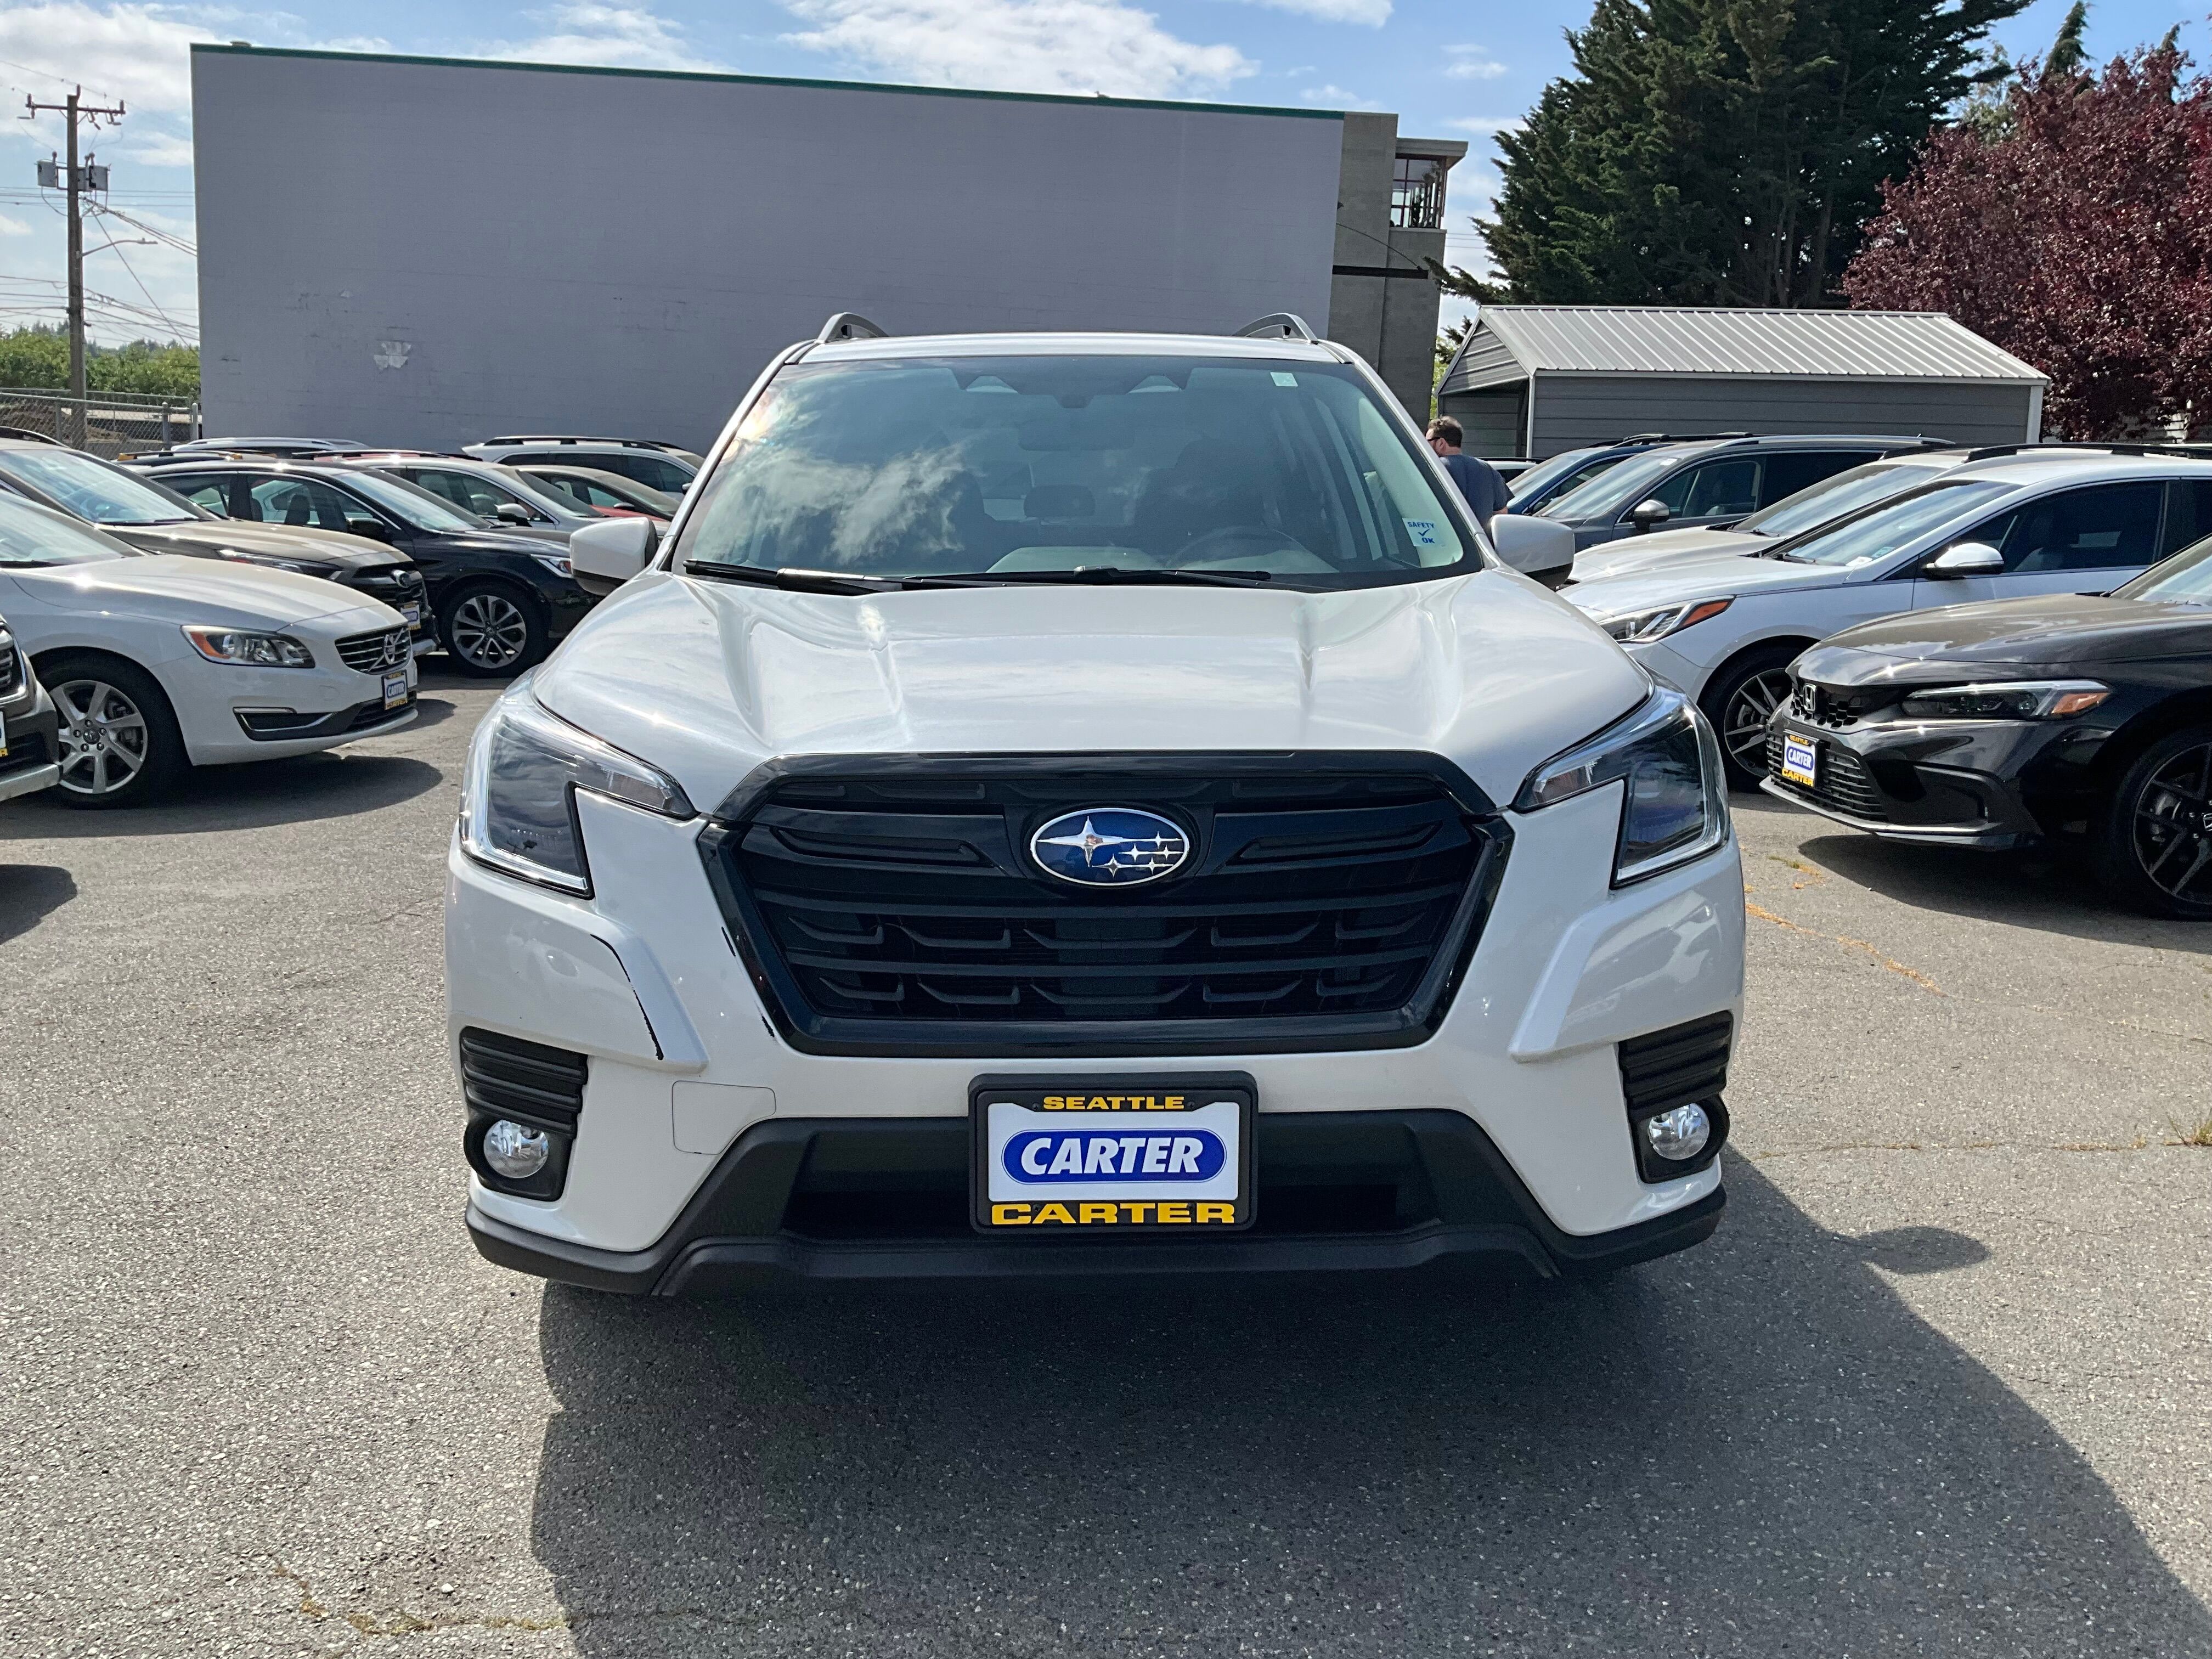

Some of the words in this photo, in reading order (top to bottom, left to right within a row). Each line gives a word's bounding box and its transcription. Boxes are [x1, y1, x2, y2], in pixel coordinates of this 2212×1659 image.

[1790, 735, 1809, 746] SEATTLE
[1788, 748, 1812, 768] CARTER
[1782, 768, 1813, 787] CARTER
[1043, 1096, 1184, 1109] SEATTLE
[1021, 1137, 1203, 1175] CARTER
[991, 1203, 1234, 1224] CARTER
